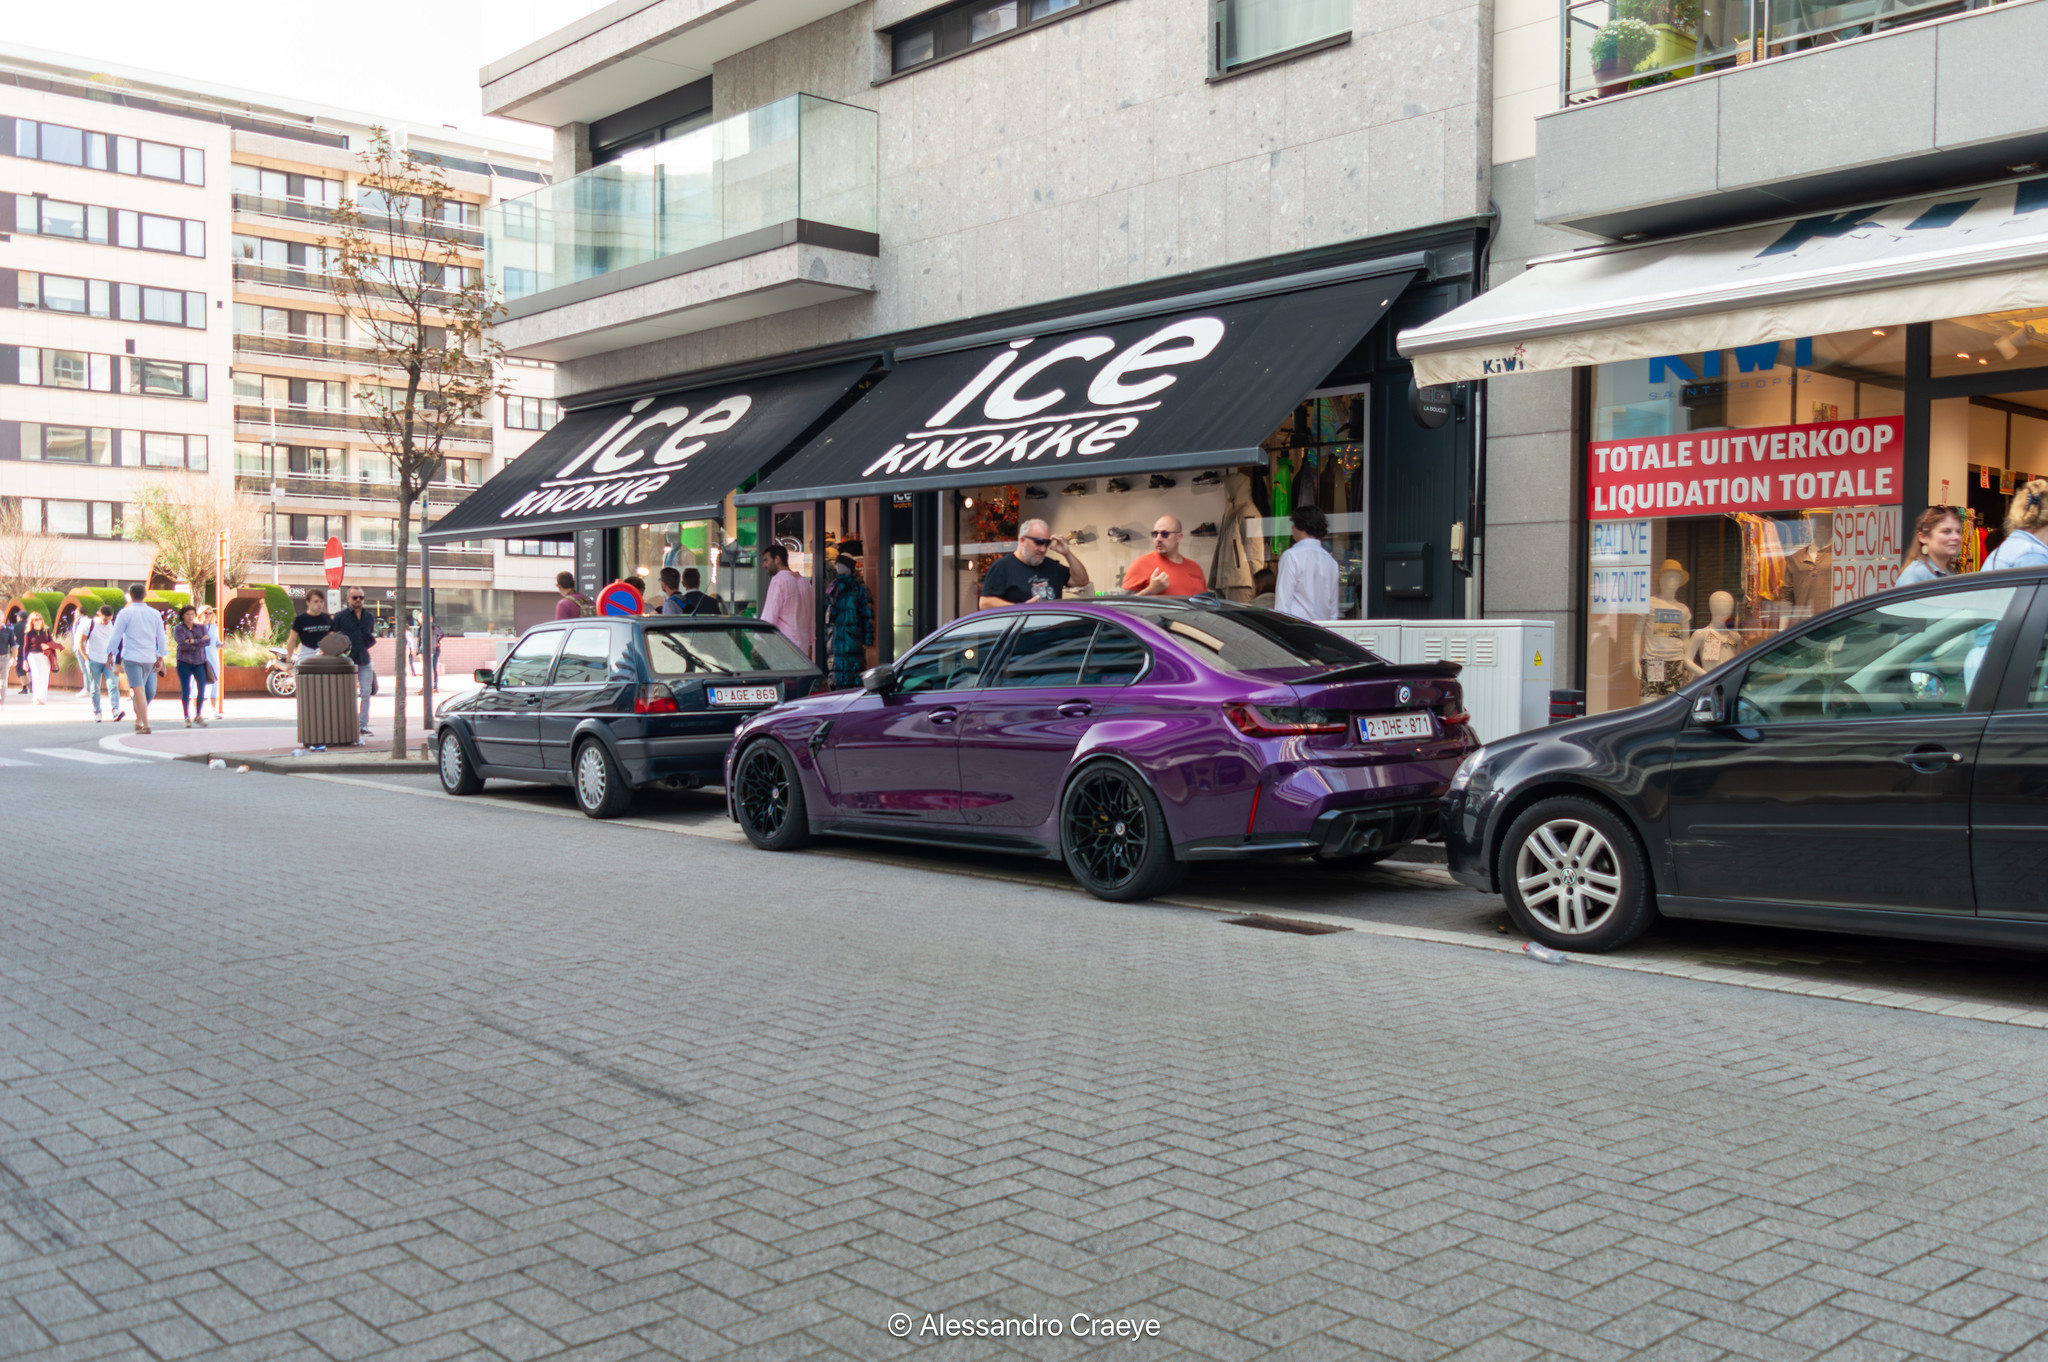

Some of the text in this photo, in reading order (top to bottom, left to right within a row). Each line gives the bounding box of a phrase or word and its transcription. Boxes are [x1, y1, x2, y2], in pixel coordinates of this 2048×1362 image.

[925, 317, 1225, 428] ice
[556, 395, 752, 478] ice
[1595, 425, 1893, 473] TOTALE UITVERKOOP
[1594, 467, 1893, 514] LIQUIDATION TOTALE
[1594, 522, 1647, 555] RALLYE
[1833, 511, 1901, 556] SPECIAL
[1594, 571, 1646, 603] DU ZOUTE
